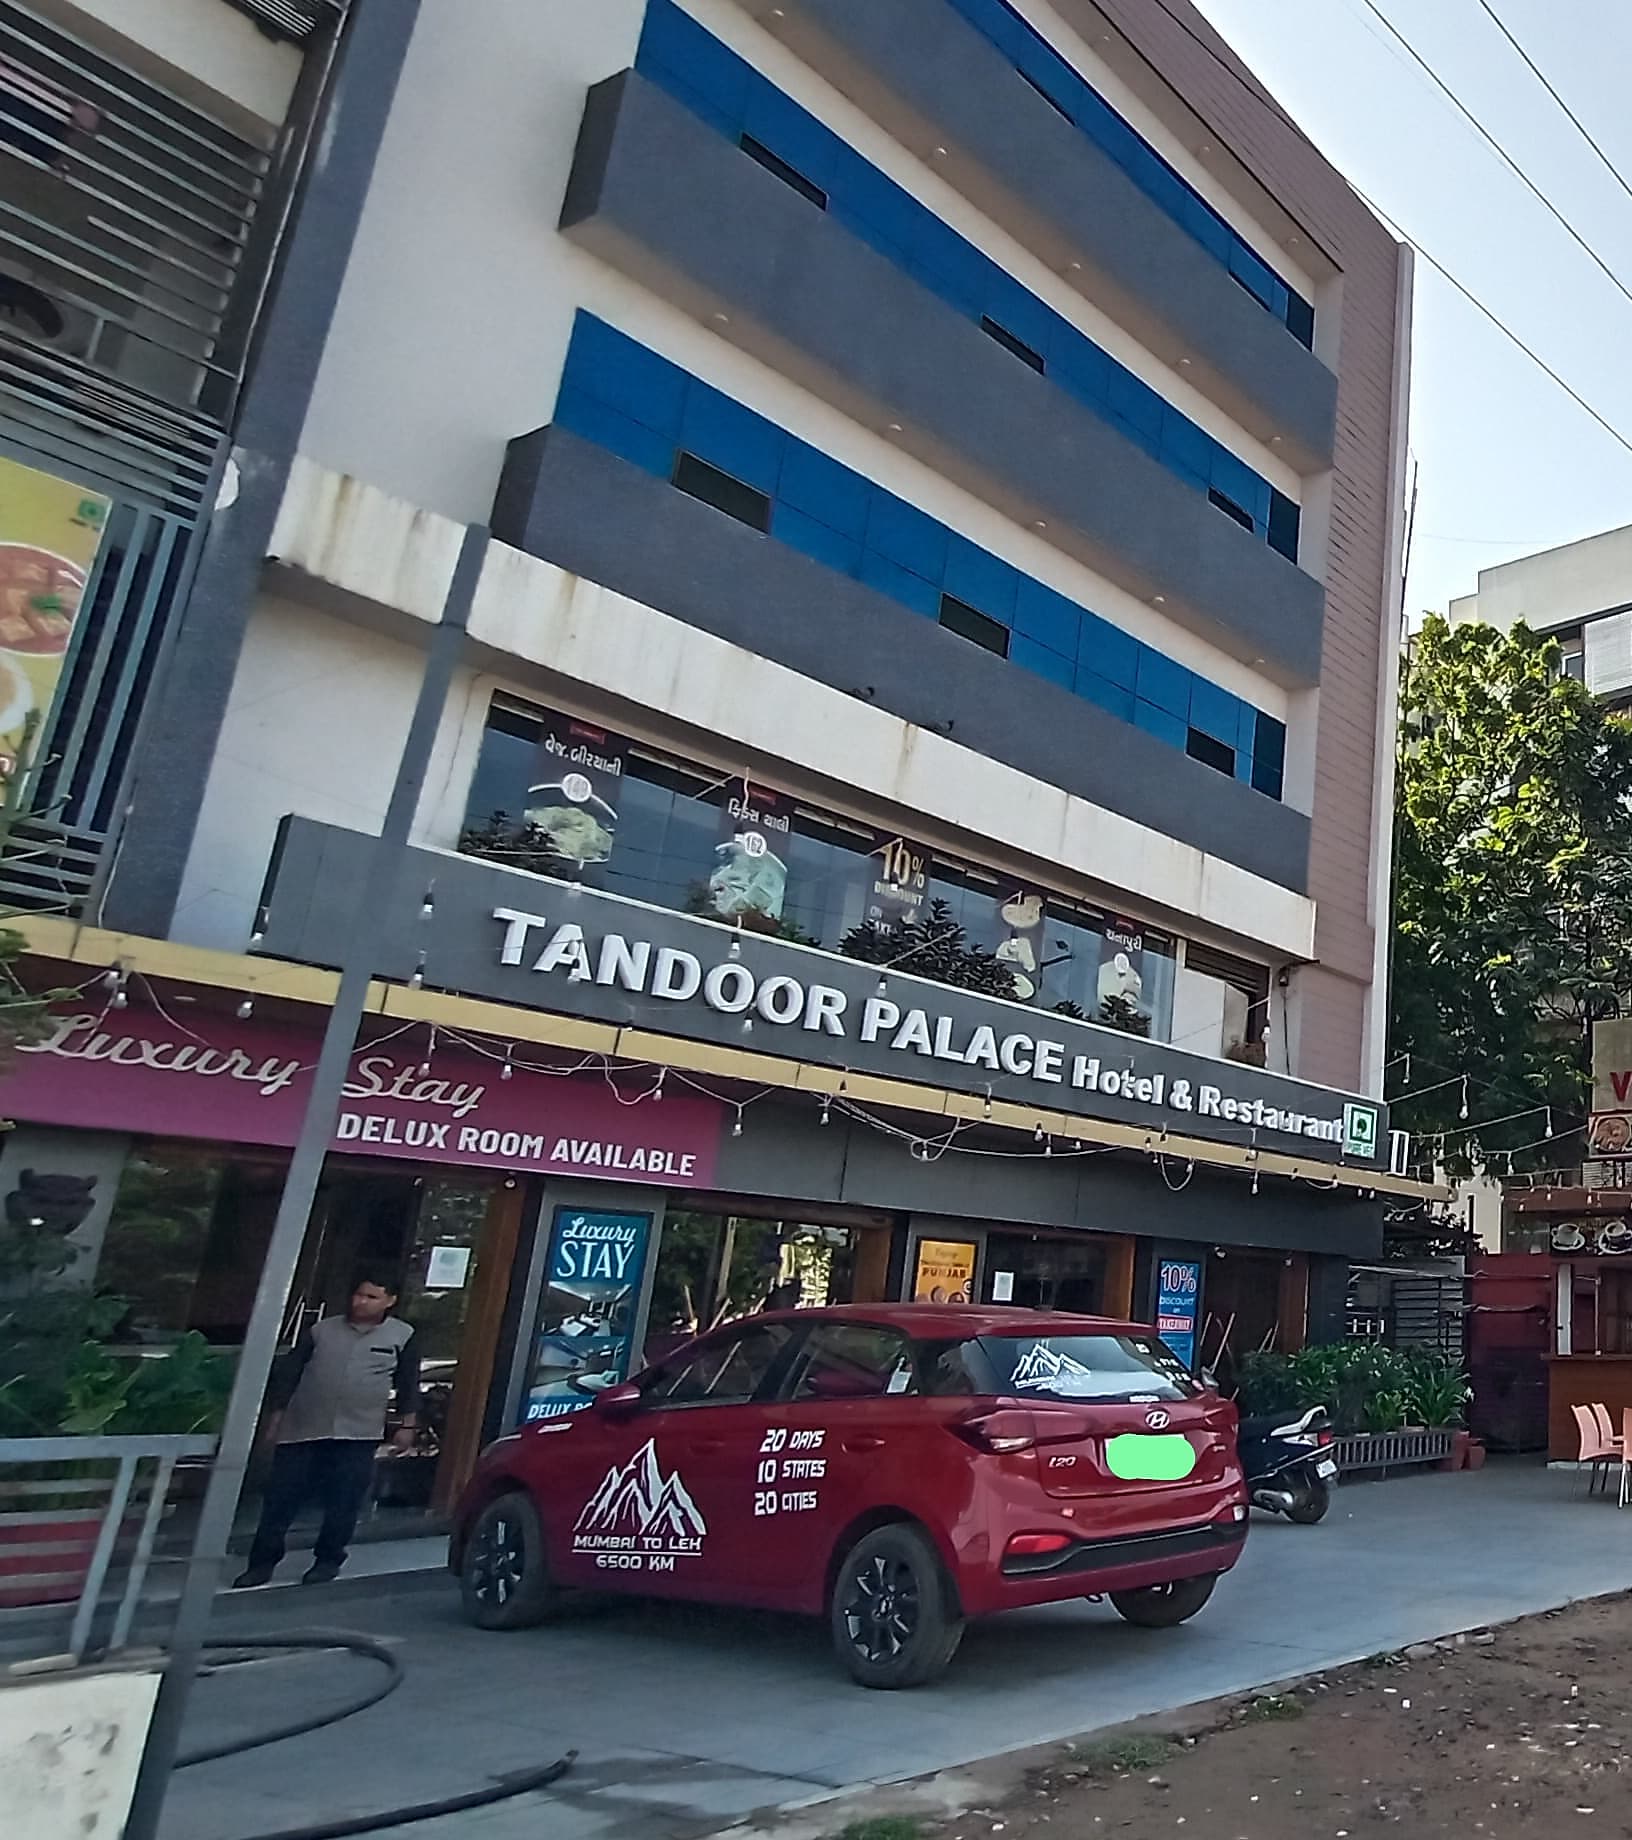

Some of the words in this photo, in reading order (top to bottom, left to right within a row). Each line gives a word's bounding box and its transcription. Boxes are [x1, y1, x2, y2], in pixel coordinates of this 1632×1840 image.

[492, 907, 847, 1036] TANDOOR
[860, 998, 1064, 1083] PALACE
[1072, 1055, 1164, 1105] Hotel
[1170, 1079, 1193, 1112] &
[1198, 1085, 1343, 1144] Restaurant
[14, 1014, 299, 1095] Luxury
[341, 1056, 485, 1118] Stay
[337, 1113, 450, 1149] DELUX
[458, 1126, 544, 1159] ROOM
[550, 1138, 697, 1177] AVAILABLE
[562, 1216, 636, 1247] Luxury
[556, 1240, 635, 1278] STAY
[1161, 1264, 1196, 1293] 10%
[759, 1428, 787, 1453] 20
[788, 1430, 826, 1450] DAYS
[757, 1459, 777, 1483] 10
[781, 1459, 826, 1479] STATES
[754, 1490, 778, 1516] 20
[781, 1490, 818, 1511] CITIES
[573, 1534, 637, 1549] MUMBAI
[642, 1536, 662, 1550] TO
[668, 1535, 702, 1550] LEH
[595, 1554, 642, 1570] 6500
[648, 1555, 675, 1572] KM
